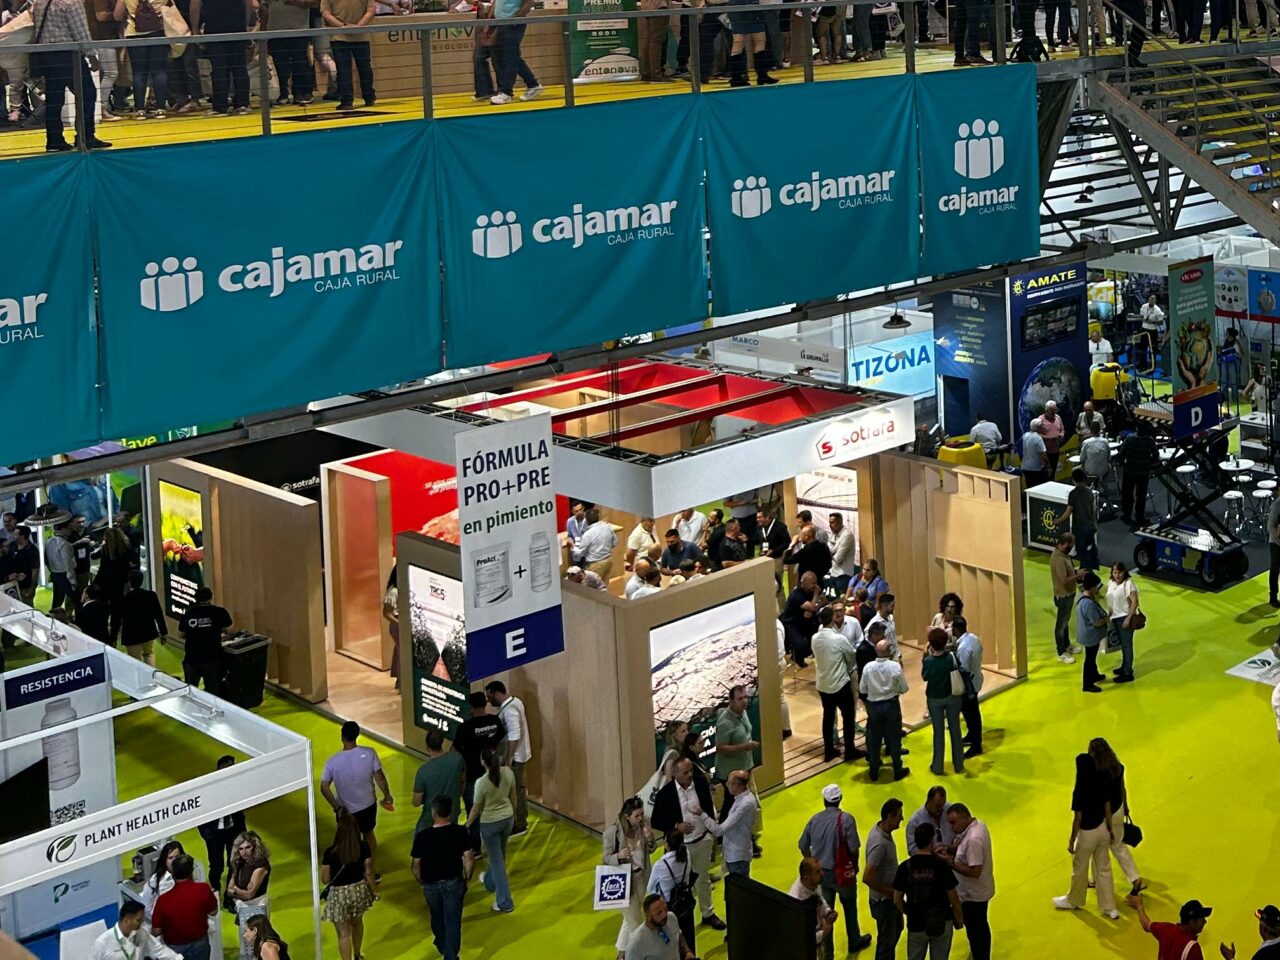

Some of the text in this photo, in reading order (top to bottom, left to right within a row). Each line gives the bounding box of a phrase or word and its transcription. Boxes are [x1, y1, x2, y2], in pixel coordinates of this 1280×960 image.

[584, 65, 638, 76] entonova
[779, 168, 896, 212] cajamar
[838, 193, 894, 209] CAJA RURAL
[938, 183, 1020, 217] cajamar
[996, 202, 1018, 213] RURAL
[532, 198, 678, 249] cajamar
[607, 226, 675, 246] CAJA RURAL
[218, 239, 403, 298] cajamar
[313, 269, 400, 294] CAJA RURAL
[1026, 269, 1077, 290] AMATE
[0, 326, 45, 342] URAL
[731, 336, 759, 346] MARCO
[851, 345, 931, 382] TIZONA
[1190, 406, 1203, 428] D
[119, 434, 158, 451] lave
[462, 438, 550, 478] FÓRMULA
[464, 466, 551, 506] PRO+PRE
[463, 499, 554, 536] en pimiento
[1037, 533, 1060, 543] AMAT
[505, 627, 527, 659] E
[20, 666, 94, 696] RESISTENCIA
[84, 795, 201, 848] PLANT HEALTH CARE
